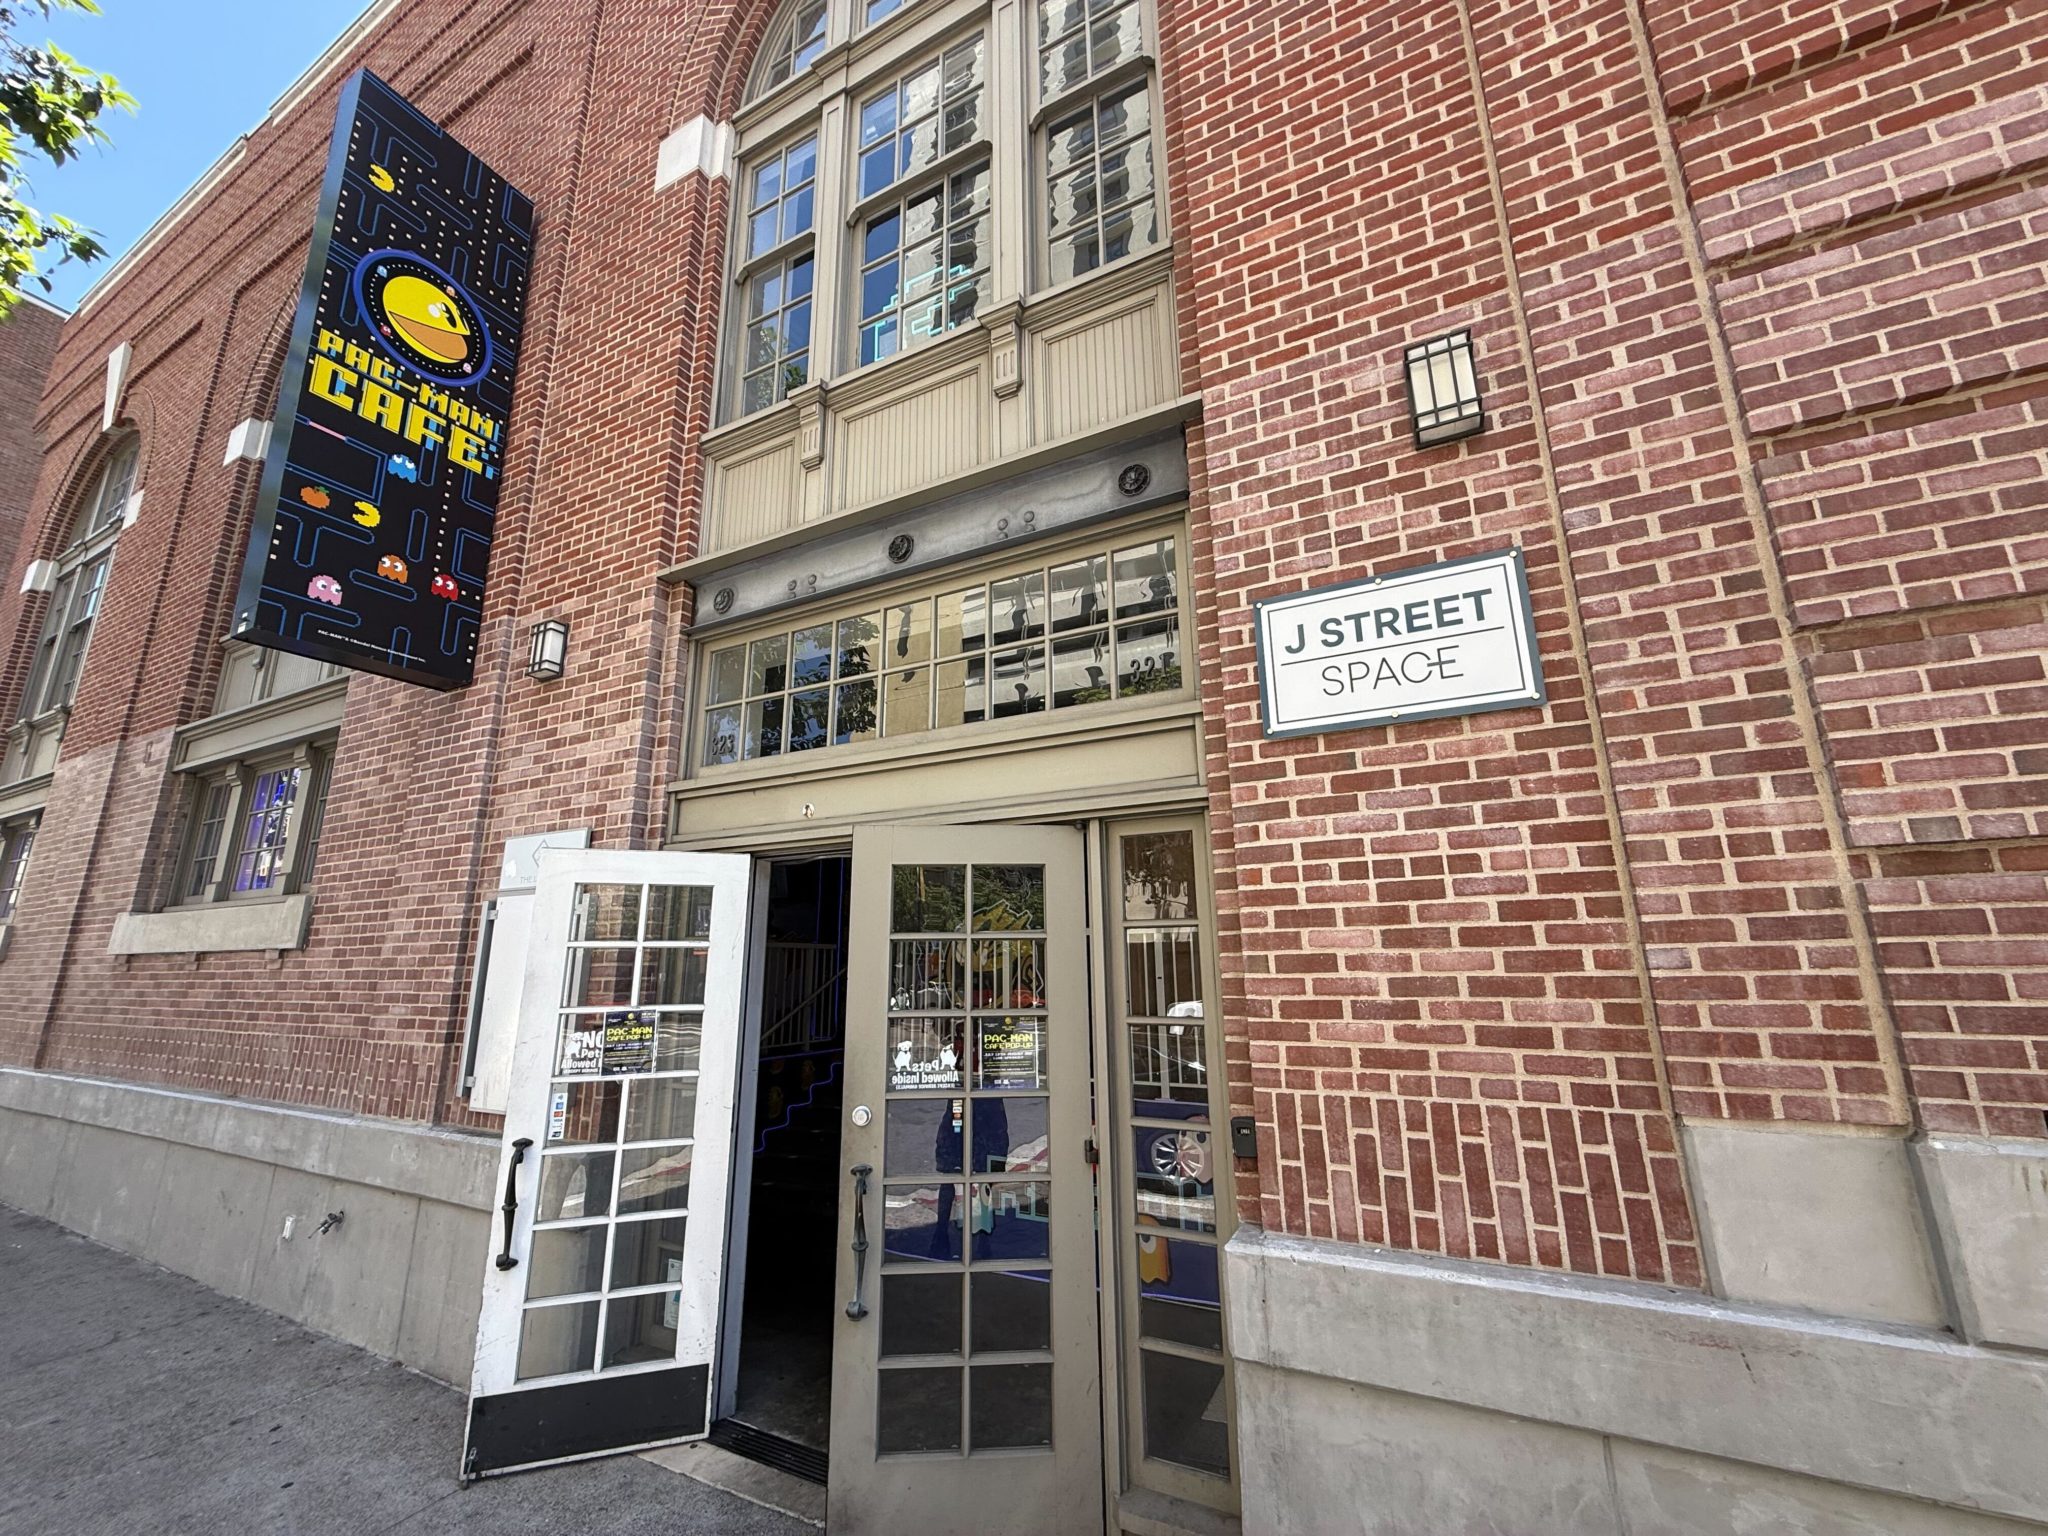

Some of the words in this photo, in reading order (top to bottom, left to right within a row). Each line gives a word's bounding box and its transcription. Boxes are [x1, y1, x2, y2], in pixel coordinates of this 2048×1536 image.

[317, 328, 497, 440] PAC-MAN
[309, 353, 490, 476] CAFE
[1284, 623, 1306, 655] J
[1320, 588, 1493, 648] STREET
[1130, 653, 1169, 682] 321
[1321, 644, 1464, 696] SPACE
[711, 734, 735, 756] 323
[606, 1026, 653, 1036] PAC-MAN
[984, 1033, 1033, 1043] PAC-MAN
[561, 1058, 596, 1069] Allowed
[580, 1048, 603, 1059] Pet
